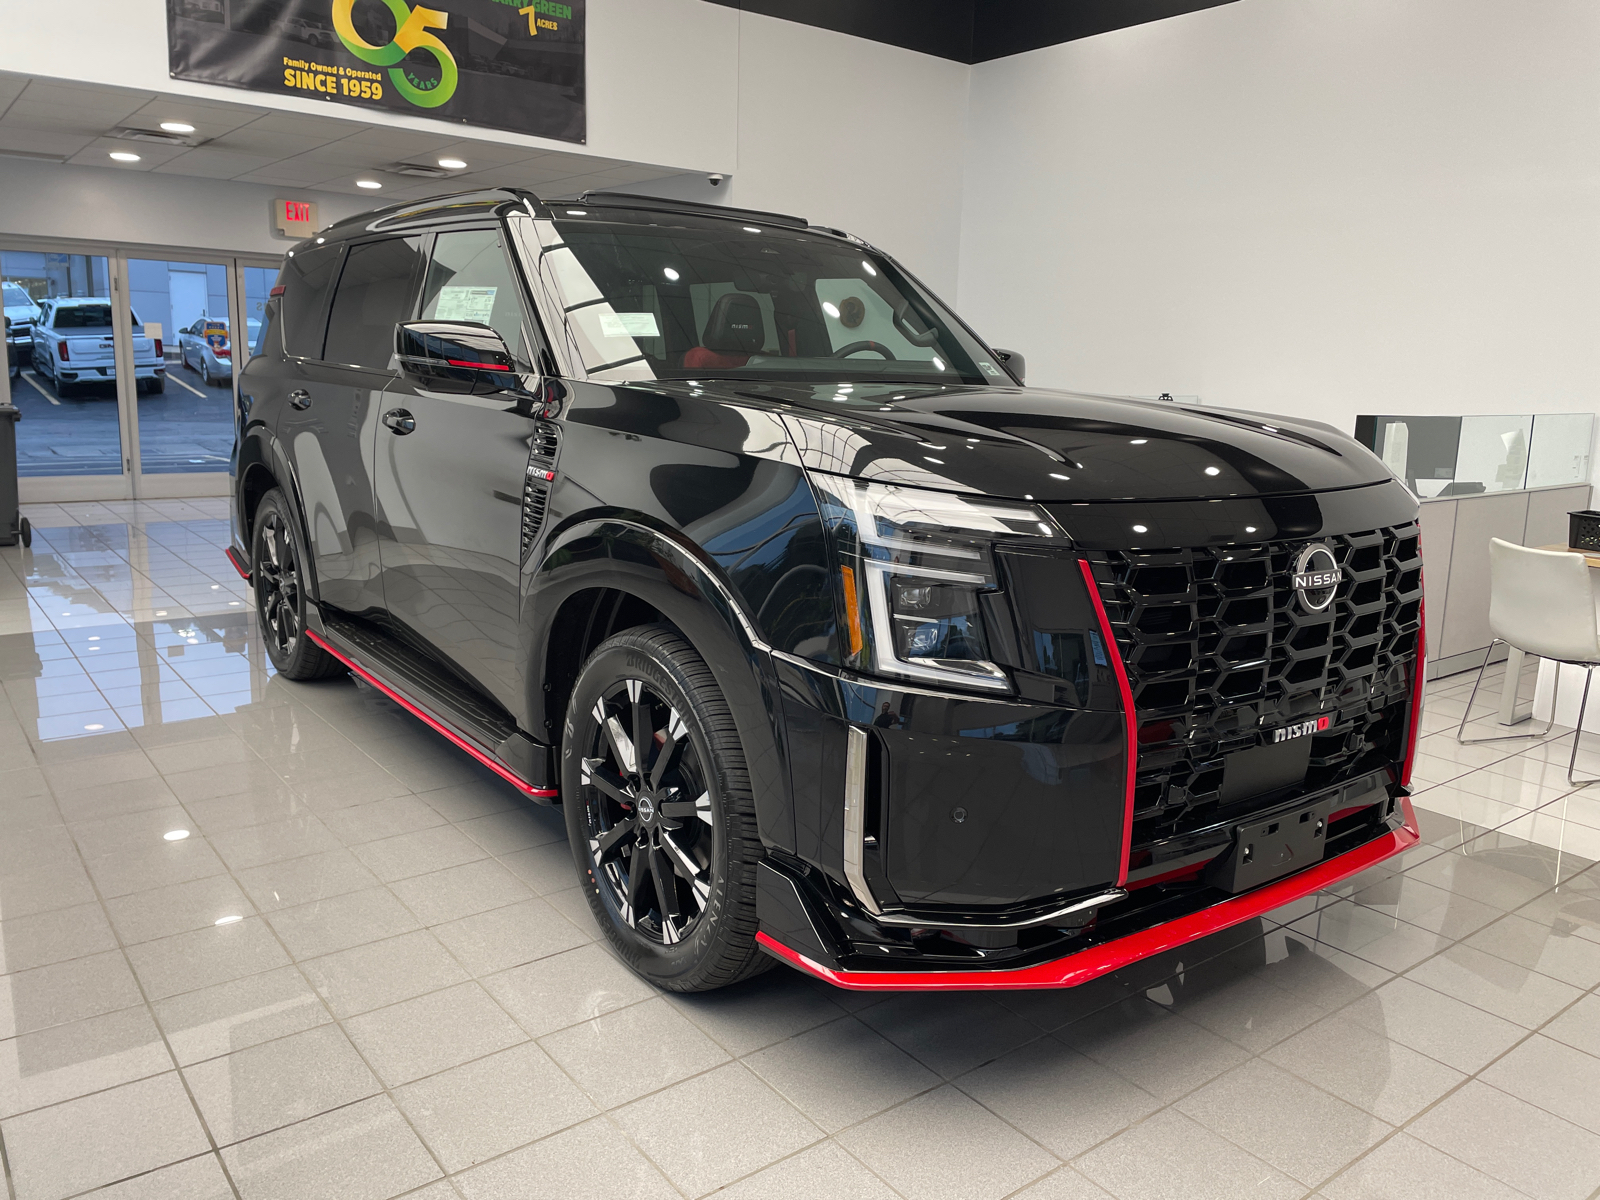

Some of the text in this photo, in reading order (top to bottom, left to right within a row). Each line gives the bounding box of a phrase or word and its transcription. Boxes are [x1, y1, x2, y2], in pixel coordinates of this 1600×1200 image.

[518, 5, 558, 36] 7 ACRES
[532, 0, 572, 20] GREEN
[283, 57, 382, 81] Family Owned & Operated
[283, 68, 383, 101] SINCE 1959
[407, 72, 439, 91] YEARS
[285, 201, 310, 222] EXIT
[1295, 569, 1342, 588] NISSAN
